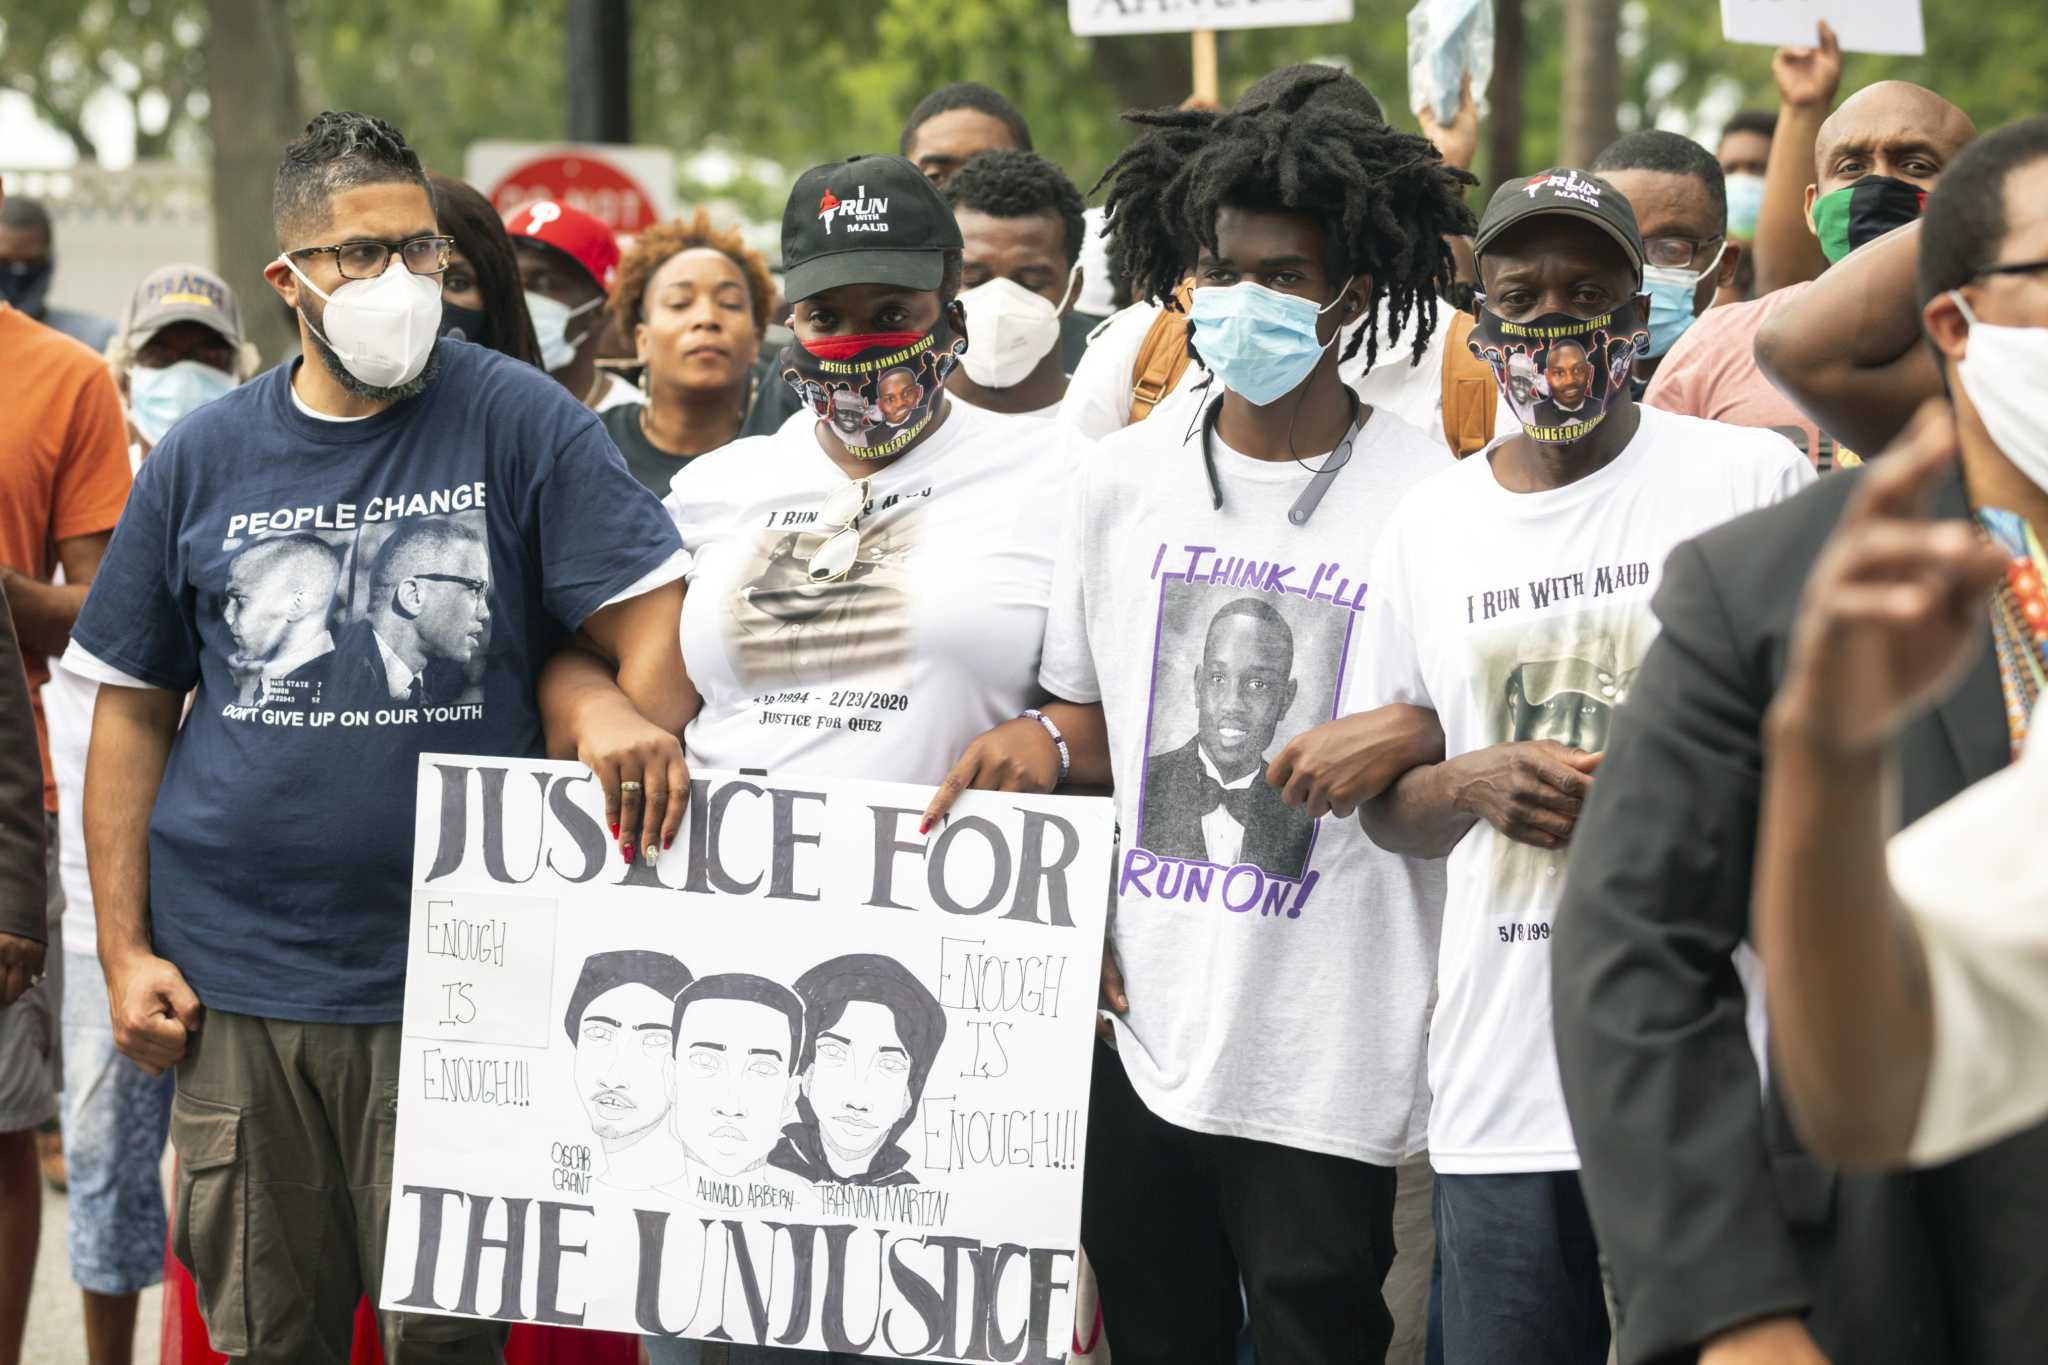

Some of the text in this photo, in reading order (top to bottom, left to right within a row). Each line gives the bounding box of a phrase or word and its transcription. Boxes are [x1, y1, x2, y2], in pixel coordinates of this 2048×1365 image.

[839, 197, 889, 215] RUN
[857, 185, 865, 198] I
[1554, 190, 1599, 208] MAUD
[847, 222, 889, 232] MAUD
[855, 213, 880, 221] WITH
[1501, 321, 1527, 336] JUSTICE
[1529, 328, 1545, 337] FOR
[819, 360, 853, 373] JUSTICE
[855, 361, 873, 373] FOR
[875, 349, 909, 369] AHMAUD
[226, 482, 487, 538] PEOPLE CHANGE
[1150, 543, 1367, 611] I THINK I'LL
[1467, 562, 1650, 623] I RUN WITH MAUD
[262, 709, 304, 726] GIVE
[309, 711, 336, 727] UP
[340, 710, 369, 726] ON
[375, 708, 418, 725] OUR
[423, 704, 483, 722] YOUTH
[829, 690, 909, 711] 2/23/2020
[759, 711, 883, 733] JUSTICE FOR QUEZ
[424, 763, 1080, 928] JUSICE FOR
[1120, 849, 1320, 919] RUN ON!
[427, 900, 507, 968] ENOUGH
[1498, 922, 1553, 943] 5/8/199
[938, 936, 1068, 1018] ENOUGH
[439, 981, 477, 1026] IS
[960, 1021, 1014, 1079] IS
[424, 1048, 530, 1107] ENOUGH!!!
[923, 1094, 1078, 1173] ENOUGH!!!
[551, 1142, 591, 1172] OSCAR
[552, 1167, 592, 1196] GRANT
[695, 1175, 743, 1207] AHMAUD
[813, 1184, 949, 1226] TRAYVON MARTIN
[394, 1184, 1075, 1364] THE UNJUSTICE
